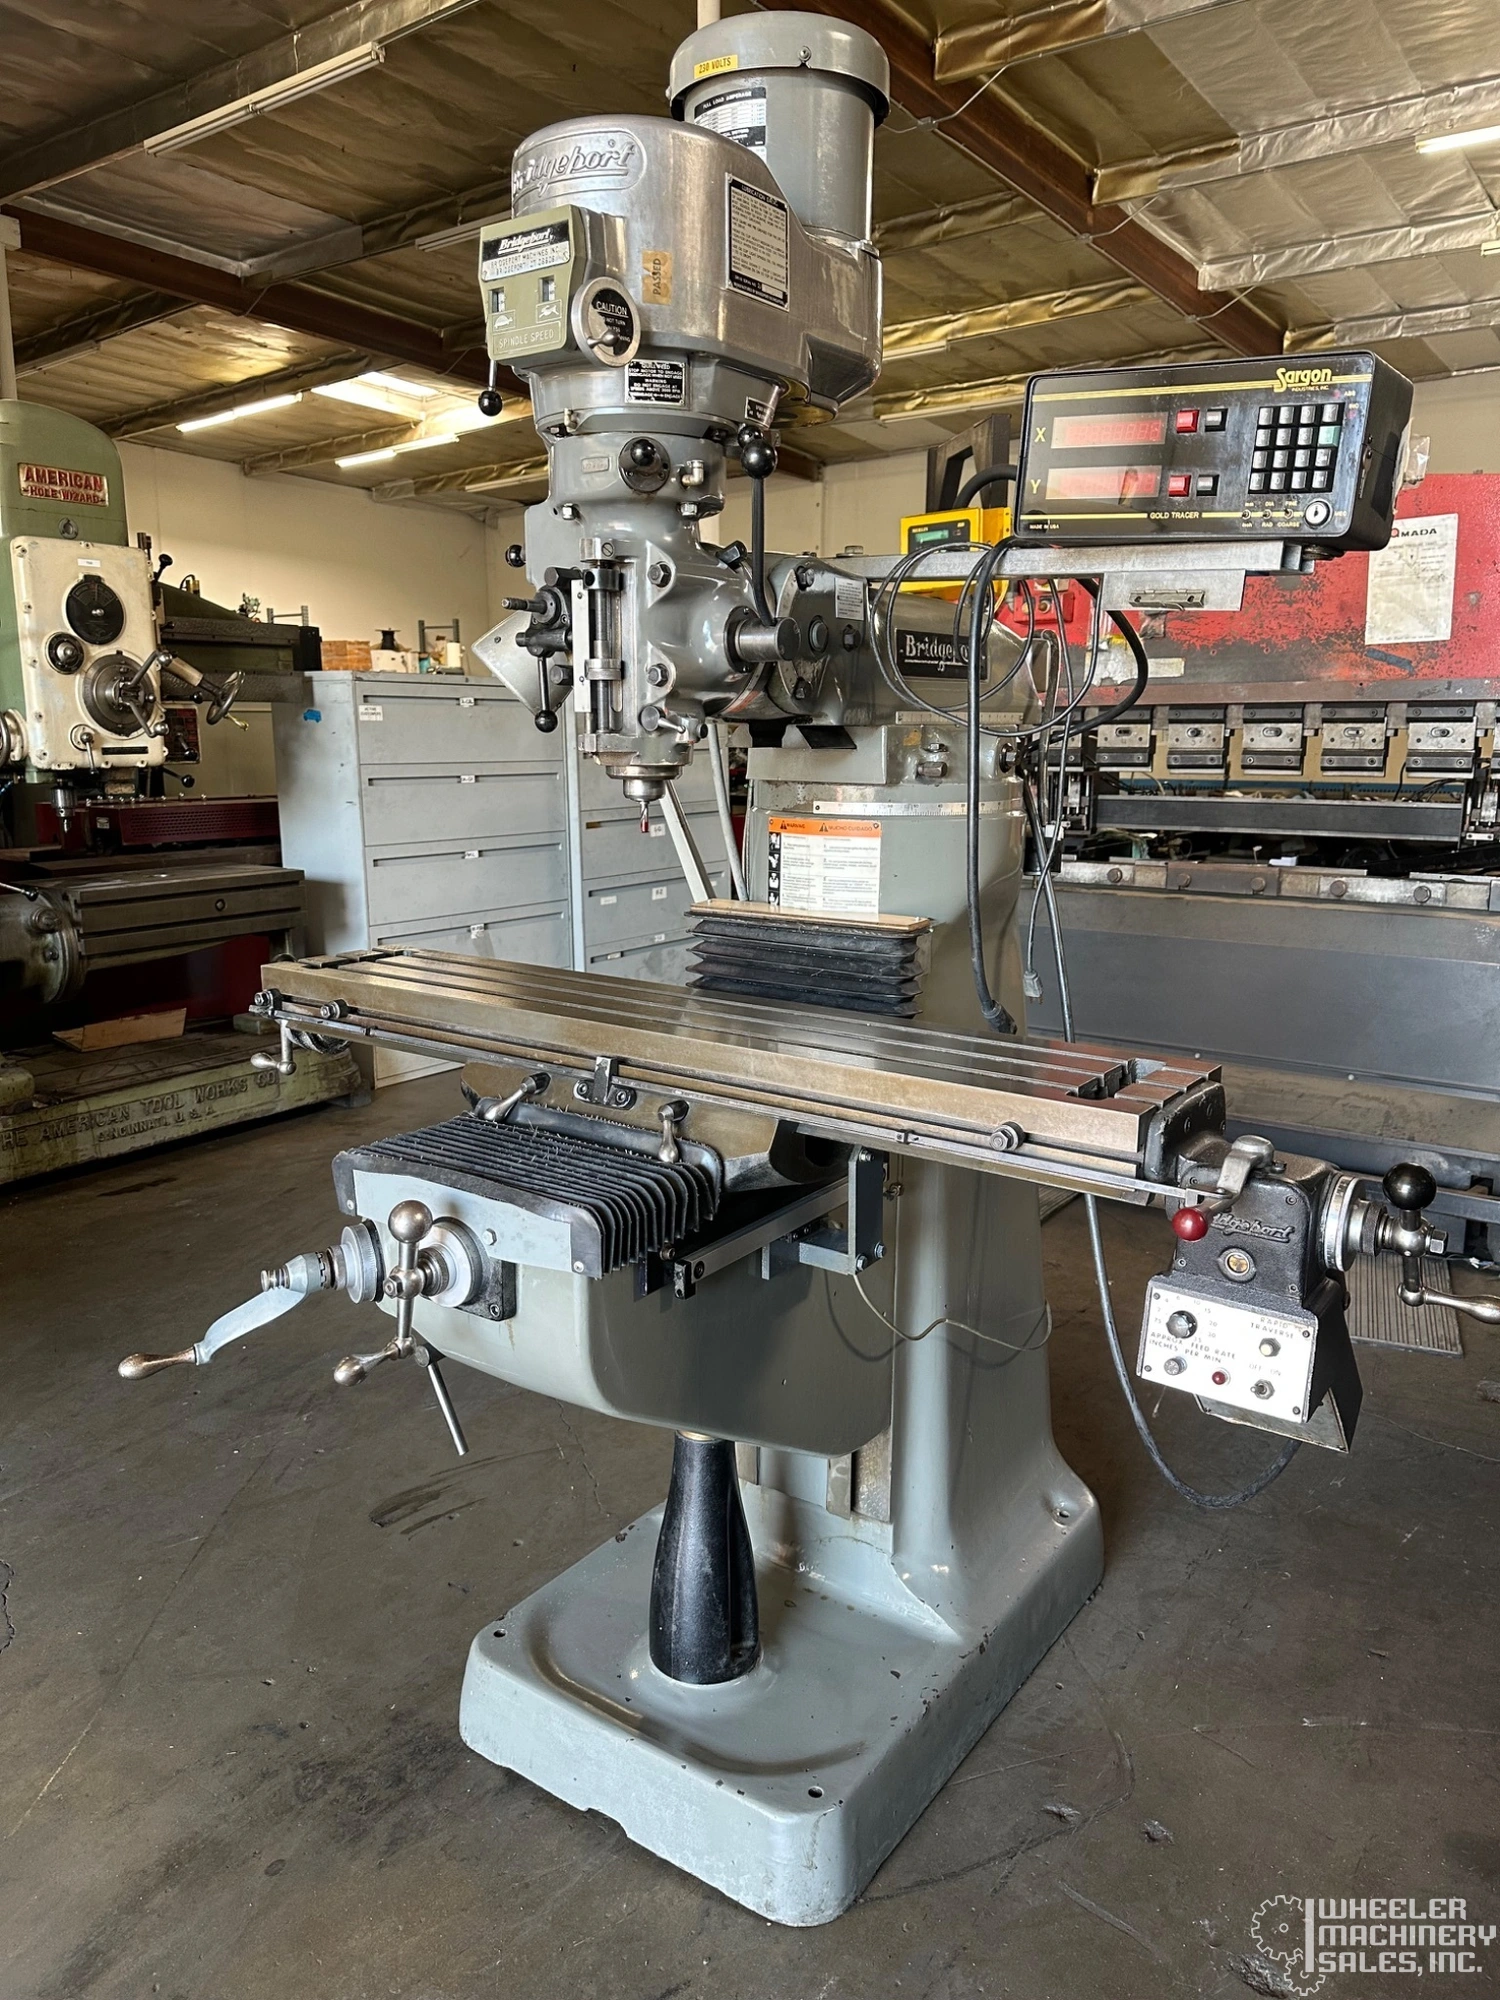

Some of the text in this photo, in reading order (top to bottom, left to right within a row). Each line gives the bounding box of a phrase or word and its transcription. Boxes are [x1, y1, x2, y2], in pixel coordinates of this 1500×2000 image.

[698, 57, 732, 74] 230 VOLTS
[498, 228, 552, 252] Bridgeport
[653, 258, 661, 296] PASSED
[595, 301, 628, 316] CAUTION
[499, 329, 554, 348] SPINDLE SPEED
[1274, 368, 1332, 393] Sargon
[1034, 427, 1047, 443] X
[24, 465, 104, 492] AMERICAN
[1030, 479, 1042, 494] Y
[1171, 511, 1200, 519] TRACER
[0, 1127, 29, 1150] HE
[39, 1105, 130, 1143] AMERICAN
[139, 1093, 185, 1116] TOOL
[194, 1076, 248, 1104] WORKS
[1211, 1212, 1296, 1243] idgeport
[1250, 1322, 1294, 1339] TRAVERSE
[1260, 1316, 1289, 1329] RAPID
[1149, 1339, 1222, 1364] INCHES PER MIN
[1150, 1331, 1237, 1360] APPROX FEED RATE
[1269, 1367, 1282, 1377] ON
